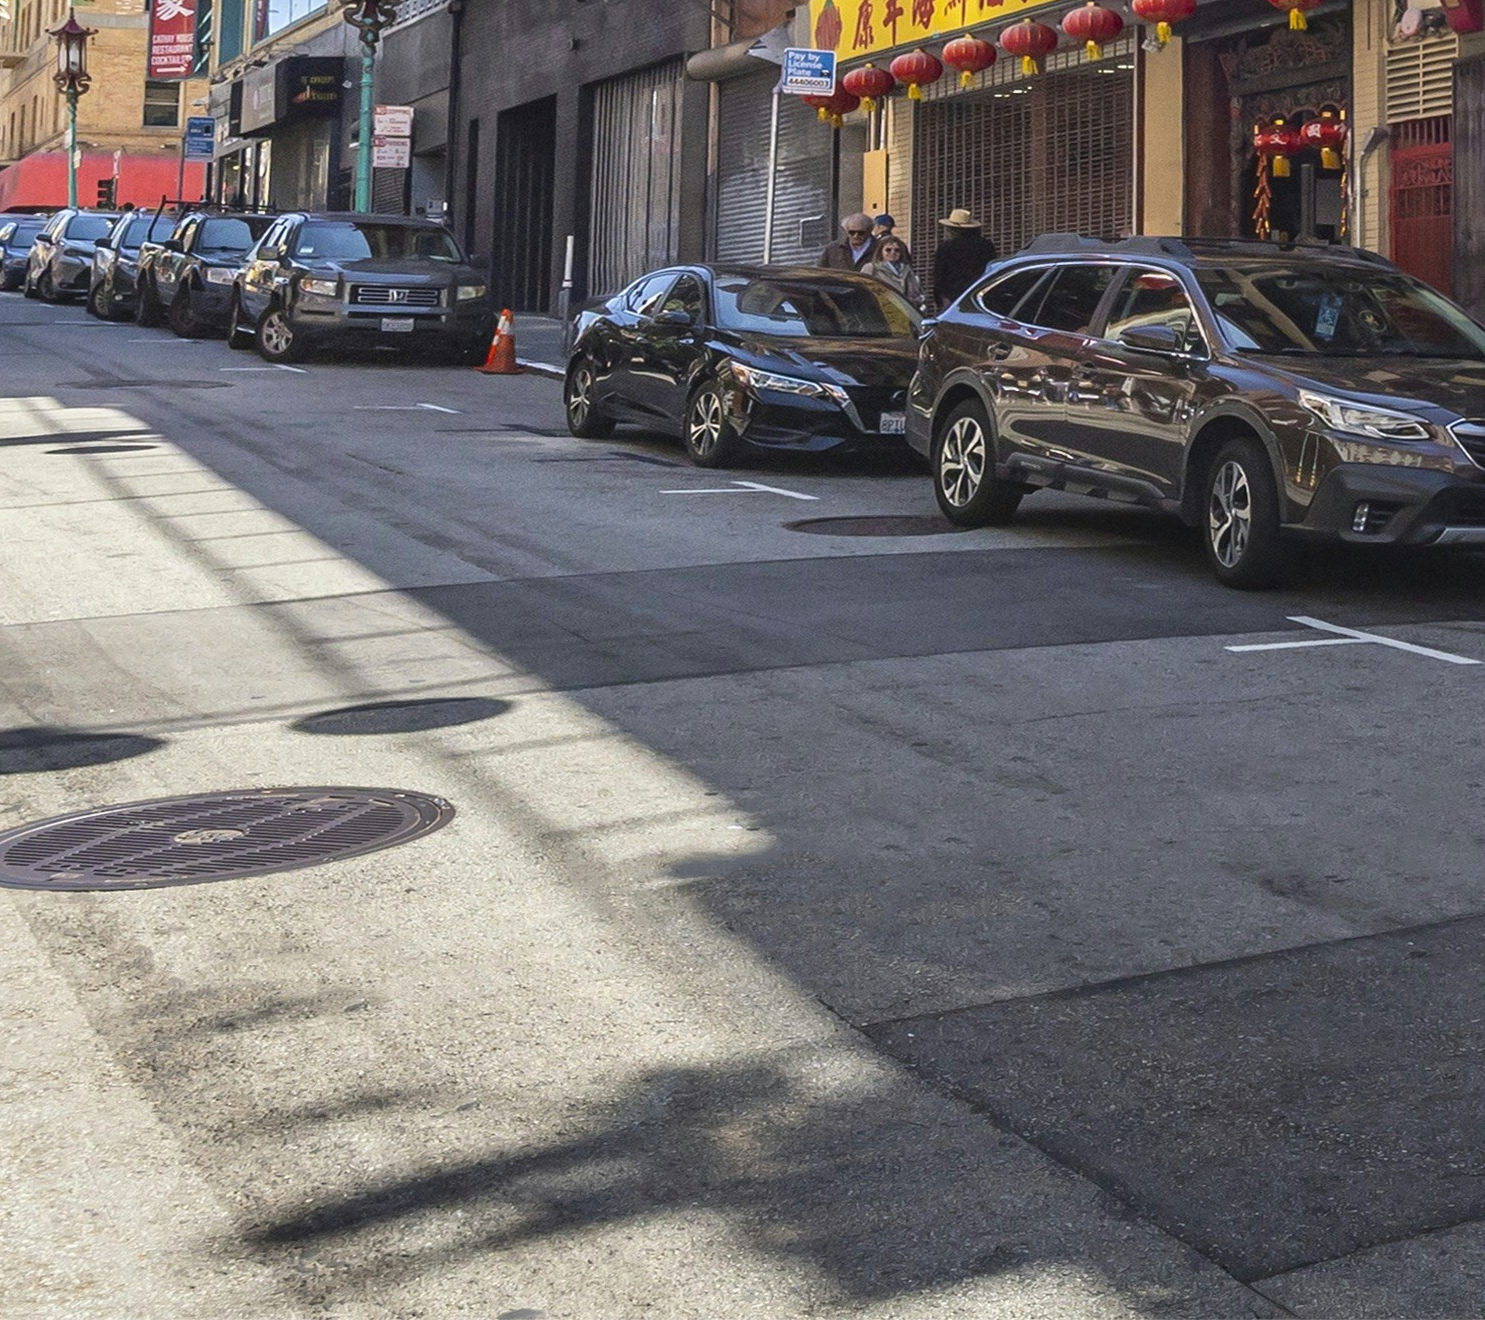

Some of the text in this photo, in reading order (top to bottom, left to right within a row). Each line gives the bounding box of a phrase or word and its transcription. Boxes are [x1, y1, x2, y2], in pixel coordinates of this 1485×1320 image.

[788, 51, 821, 64] Pay by
[788, 59, 824, 70] License
[787, 68, 812, 77] Plate
